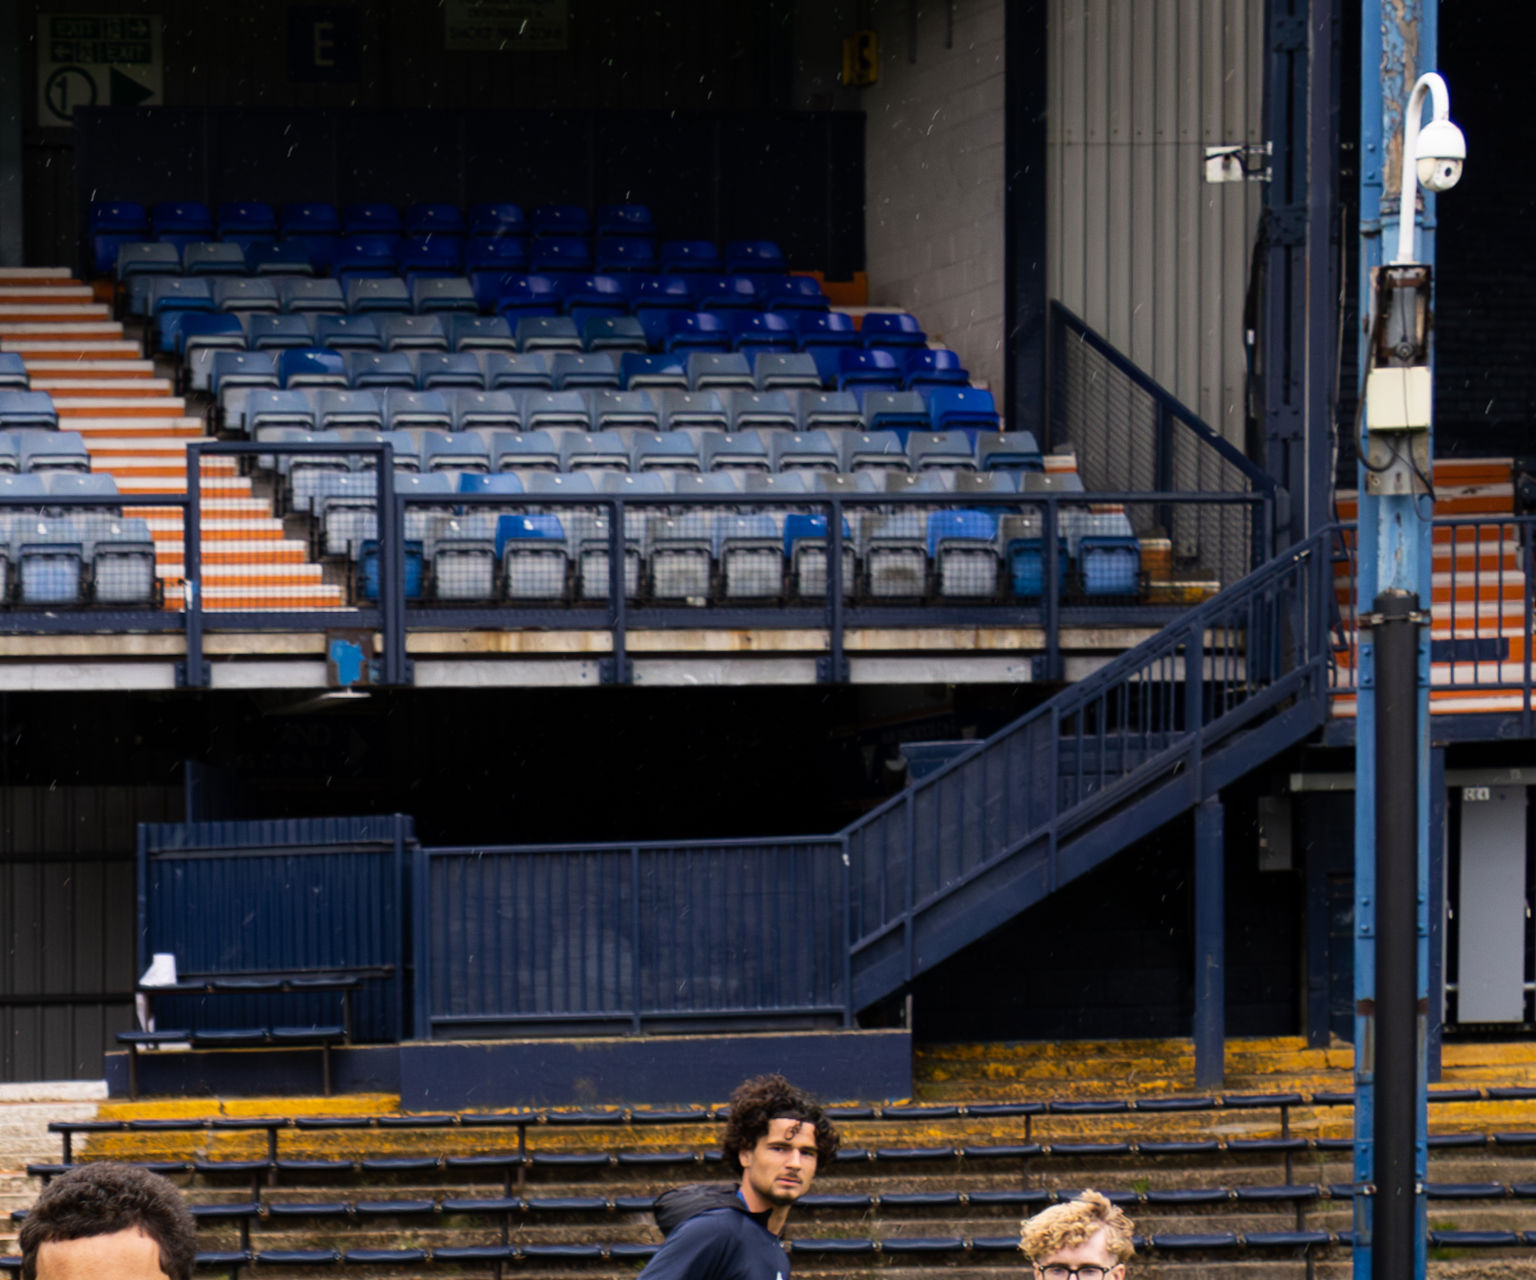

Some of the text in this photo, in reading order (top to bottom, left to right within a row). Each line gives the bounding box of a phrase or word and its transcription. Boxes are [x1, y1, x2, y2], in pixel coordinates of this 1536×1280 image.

[55, 21, 95, 35] EXIT
[107, 45, 146, 59] EXIT
[314, 22, 336, 67] E
[55, 76, 66, 112] 1
